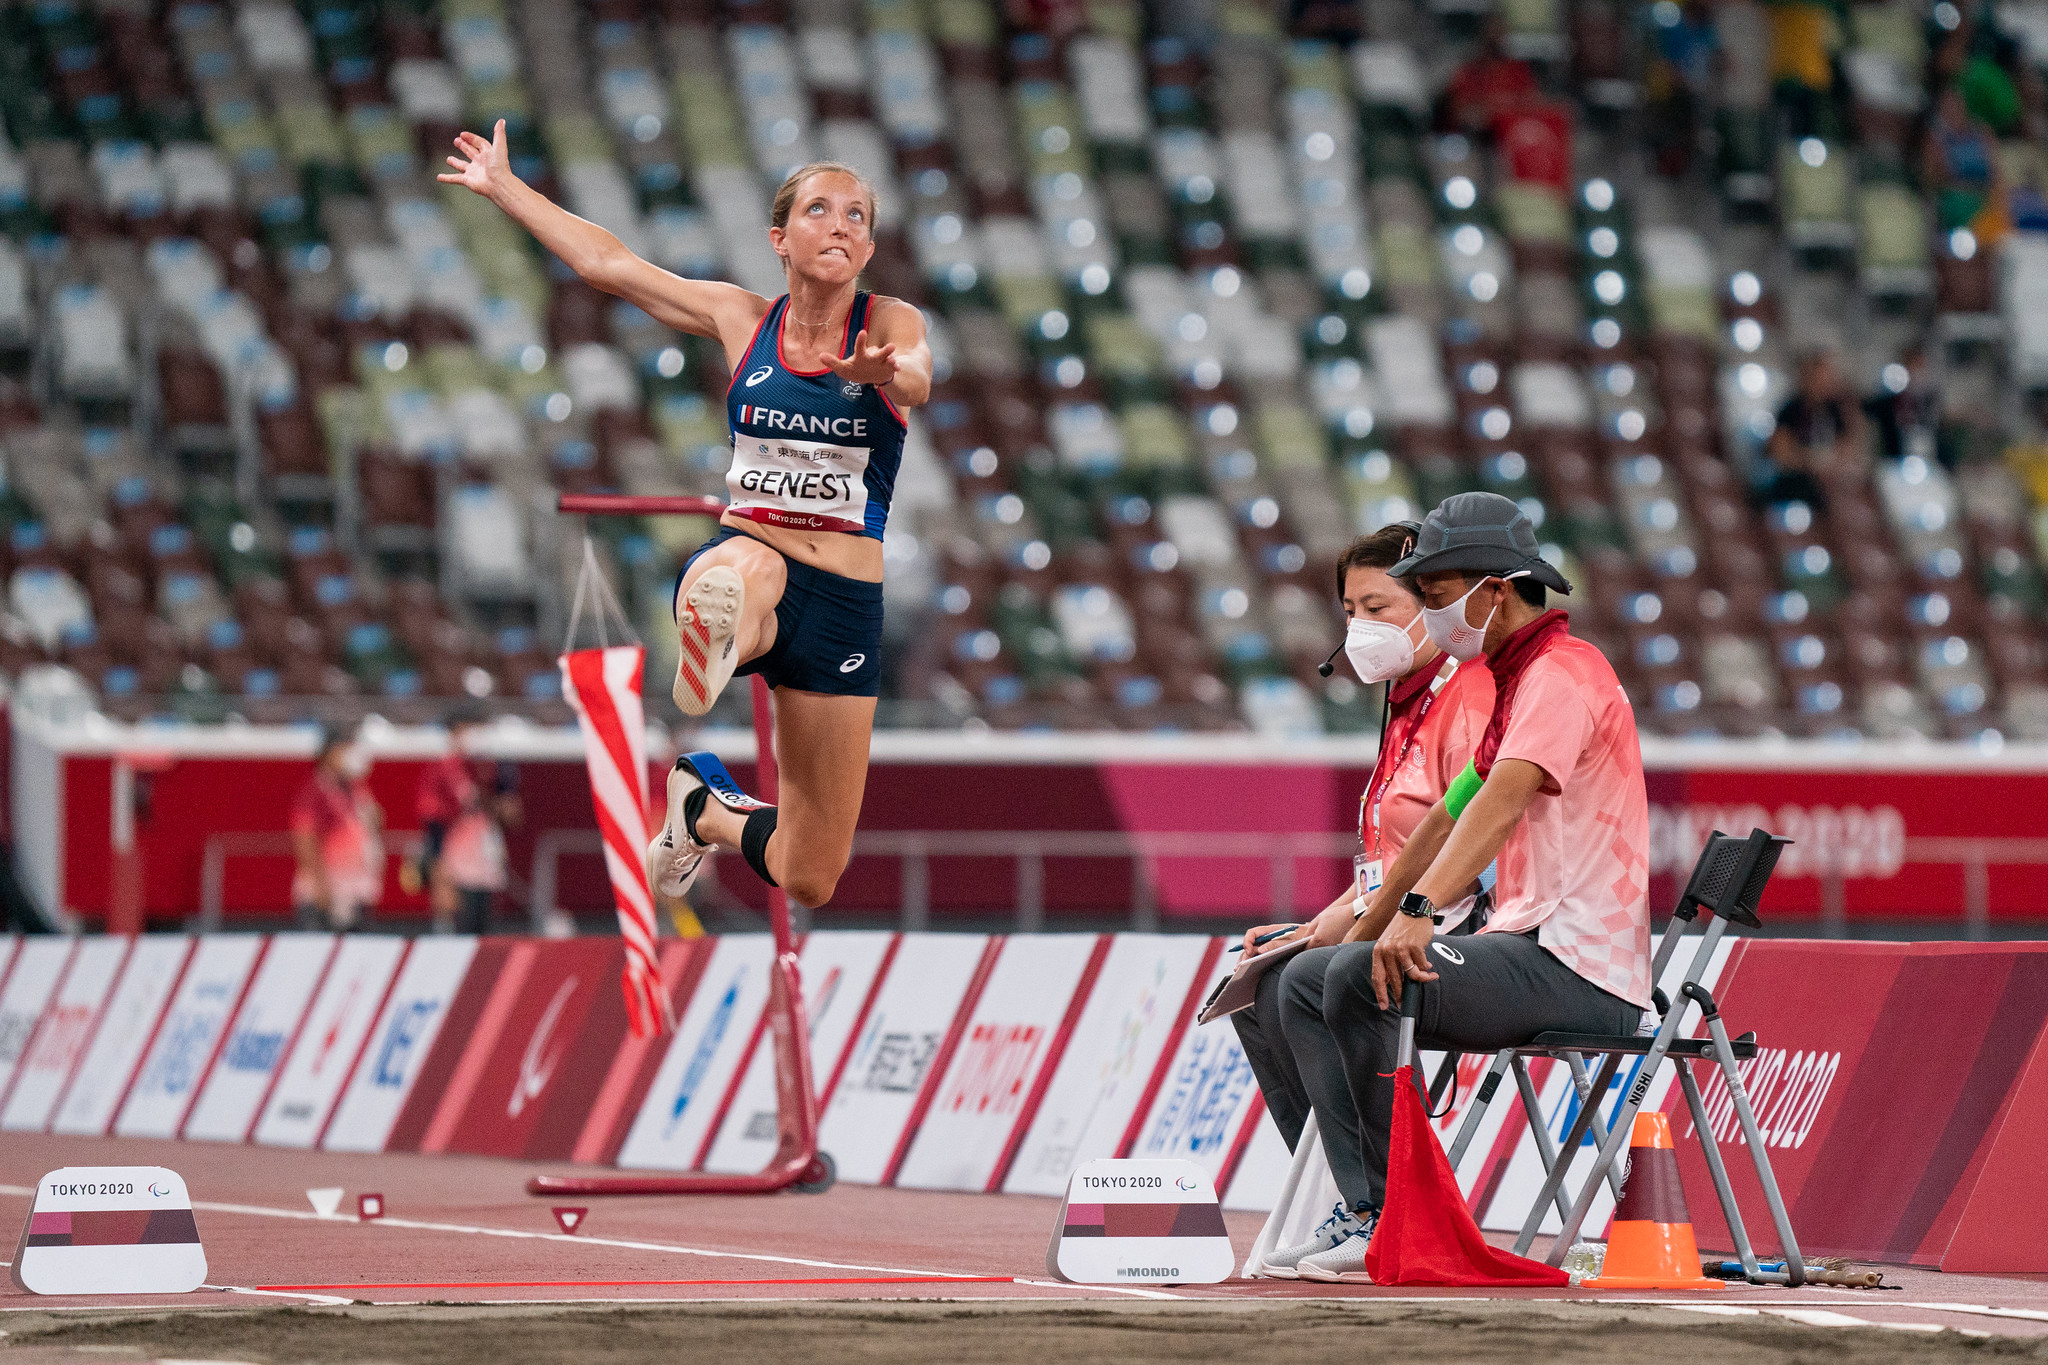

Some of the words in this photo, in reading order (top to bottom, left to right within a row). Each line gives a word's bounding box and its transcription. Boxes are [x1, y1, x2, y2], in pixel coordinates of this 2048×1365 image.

[752, 406, 867, 437] FRANCE
[777, 446, 844, 462] 東京海上日動
[740, 470, 851, 502] GENEST
[768, 512, 789, 523] TOKYO
[789, 517, 807, 525] 2020
[709, 774, 762, 809] ottob
[1628, 1072, 1652, 1107] NISHI
[1761, 1049, 1841, 1149] 2020
[50, 1184, 97, 1196] TOKYO
[100, 1183, 134, 1195] 2020
[1083, 1176, 1127, 1188] TOKYO
[1130, 1176, 1162, 1188] 2020
[1127, 1267, 1180, 1277] MONDO
